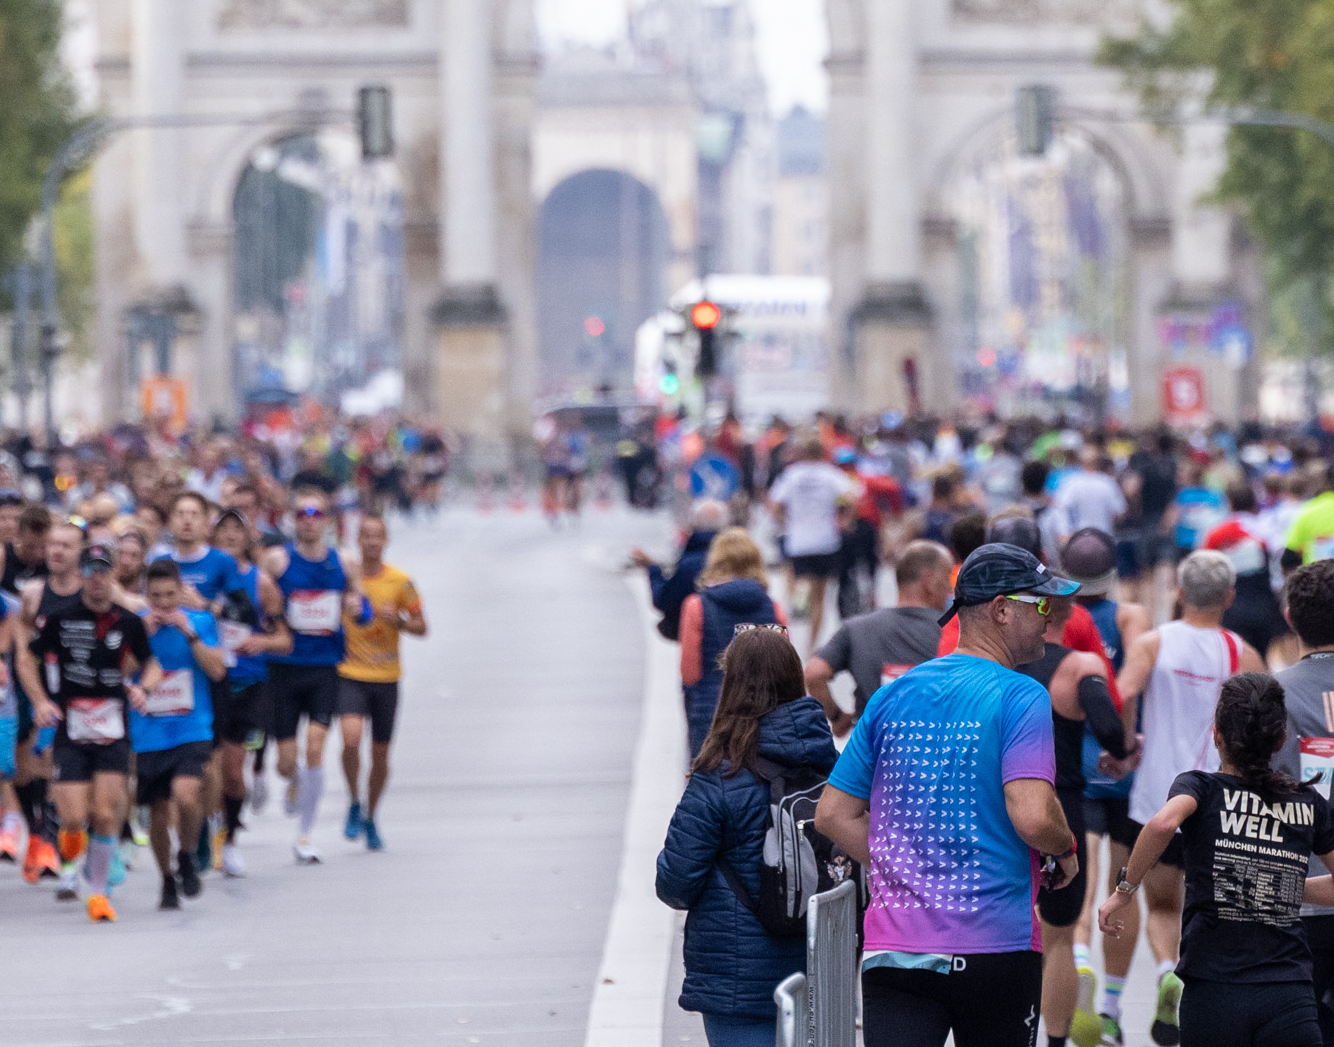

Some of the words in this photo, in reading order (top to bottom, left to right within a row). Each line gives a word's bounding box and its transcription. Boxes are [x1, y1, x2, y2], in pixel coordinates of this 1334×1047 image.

[1223, 788, 1315, 826] VITAMIN
[1220, 810, 1283, 843] WELL
[1215, 838, 1257, 853] MÜNCHEN
[1258, 846, 1299, 861] MARATHON
